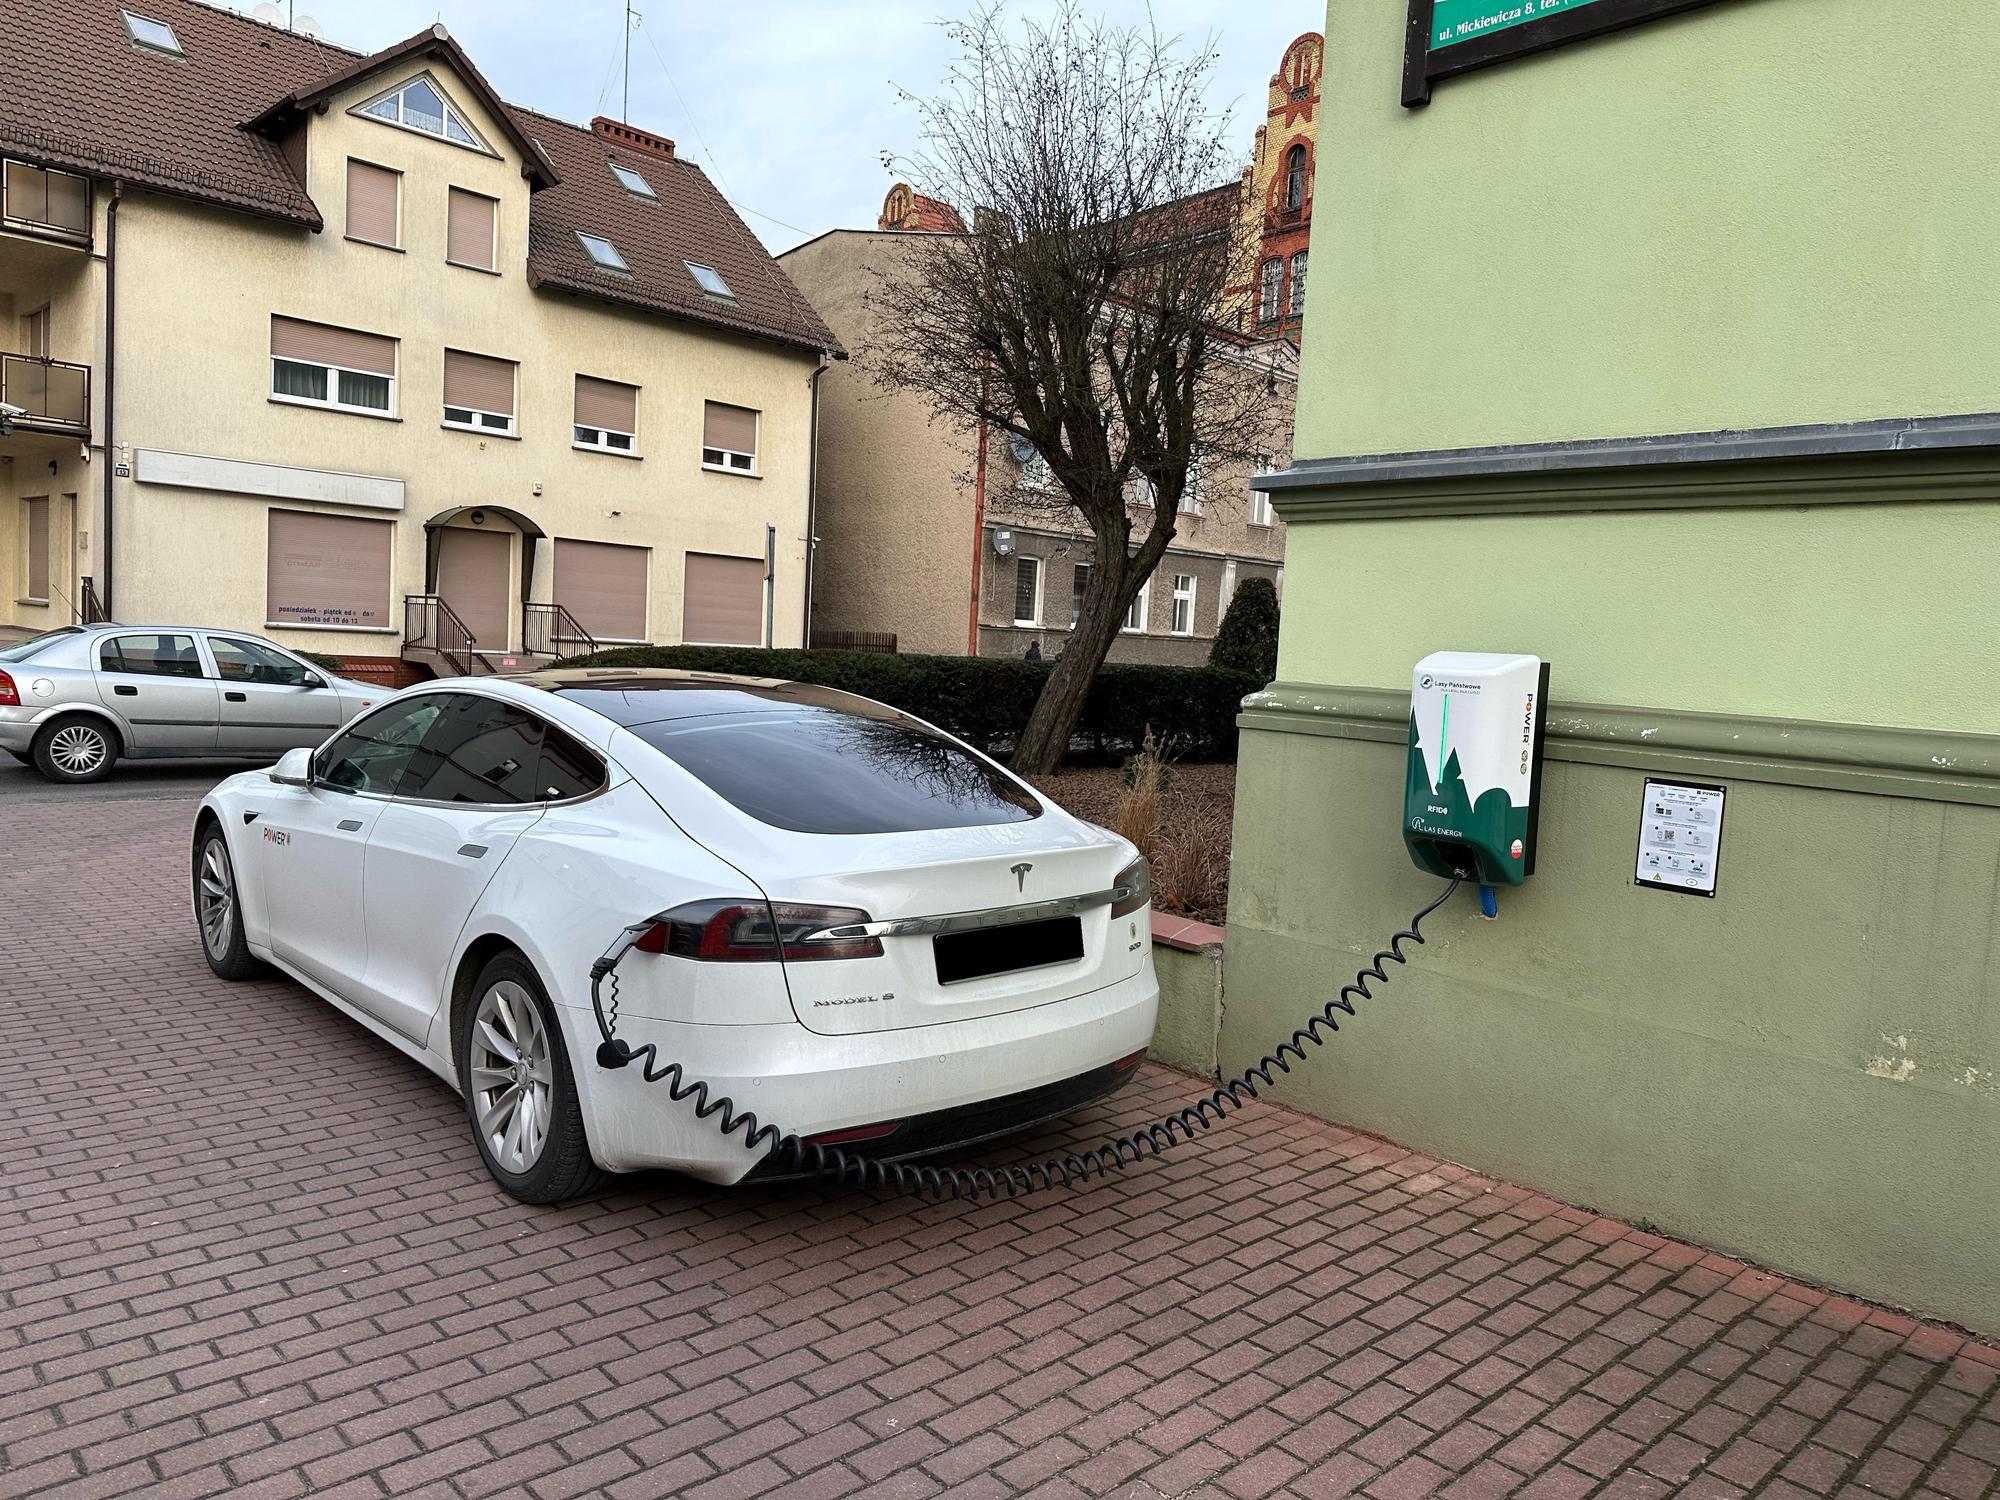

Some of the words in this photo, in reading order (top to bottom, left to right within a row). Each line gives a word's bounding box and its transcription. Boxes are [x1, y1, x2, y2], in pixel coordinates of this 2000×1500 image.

[1439, 28, 1453, 41] ul.
[1456, 8, 1521, 35] Mickiewicza
[1524, 2, 1536, 14] 8,
[323, 608, 343, 616] piątek
[1434, 680, 1448, 688] Lasy
[1448, 681, 1481, 690] Państwowe
[1522, 693, 1534, 744] POWER
[263, 827, 286, 846] POWER
[1424, 825, 1436, 834] LAS
[813, 996, 879, 1007] MODEL
[882, 992, 895, 1000] S
